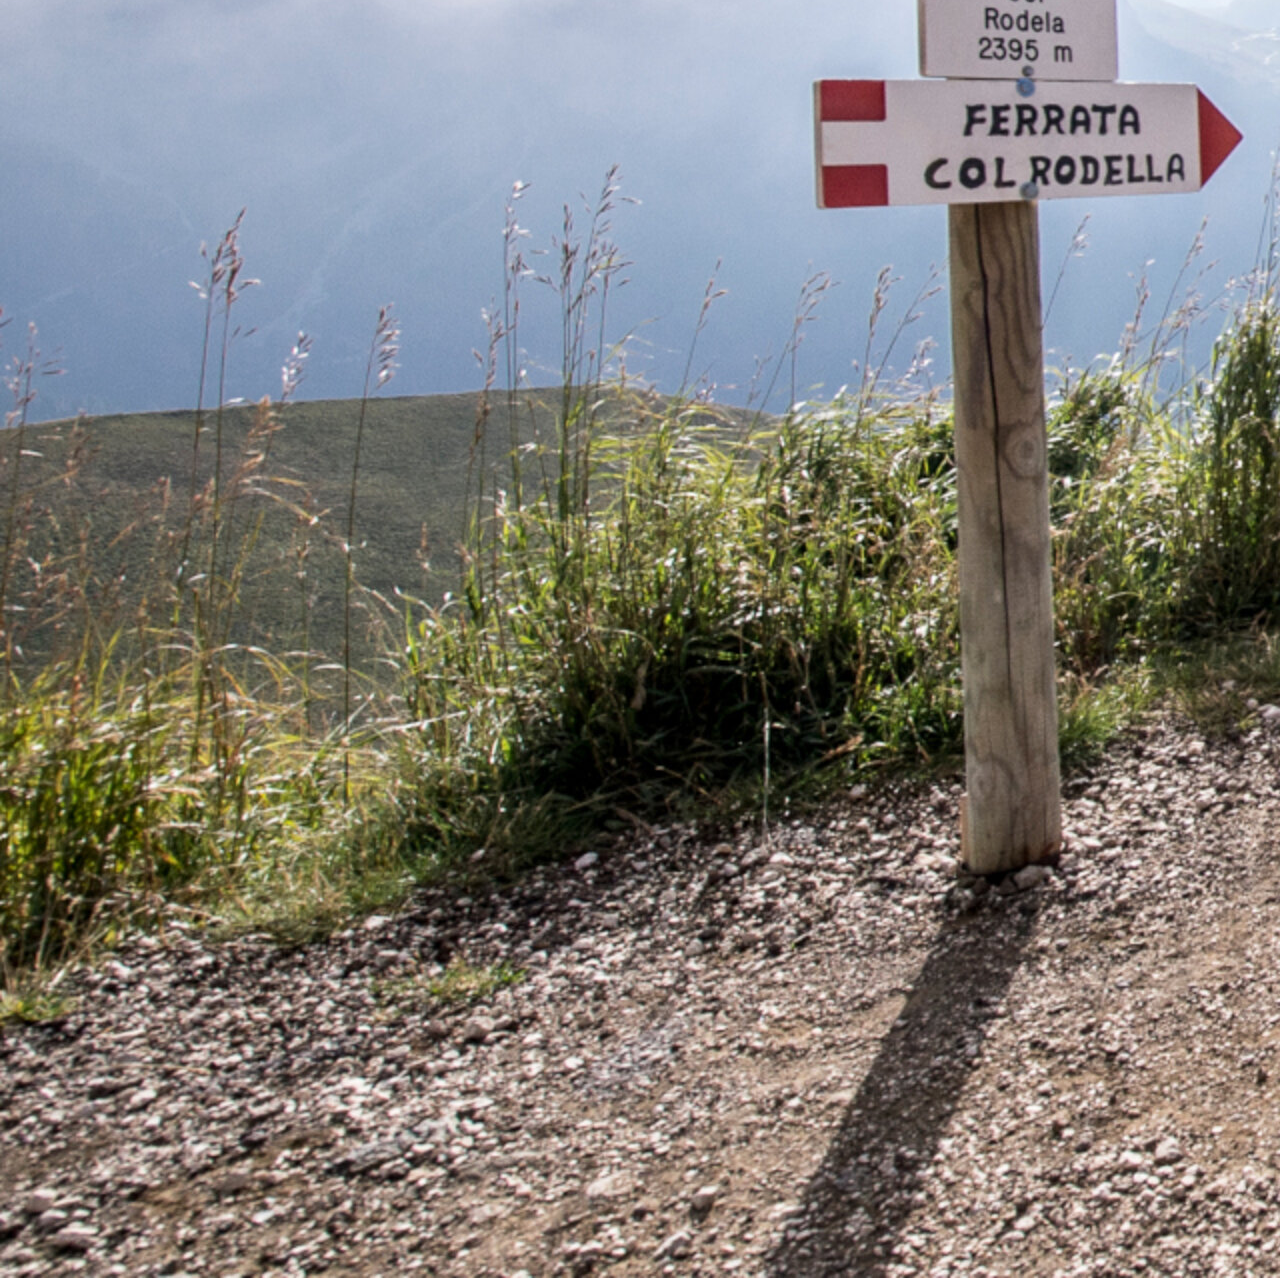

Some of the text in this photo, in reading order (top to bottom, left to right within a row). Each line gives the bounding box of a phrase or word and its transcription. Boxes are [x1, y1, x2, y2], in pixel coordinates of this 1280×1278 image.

[983, 7, 1065, 34] Rodela
[978, 38, 1074, 63] 2395 m
[962, 103, 1141, 137] FERRATA
[923, 153, 1186, 190] COL RODELLA
